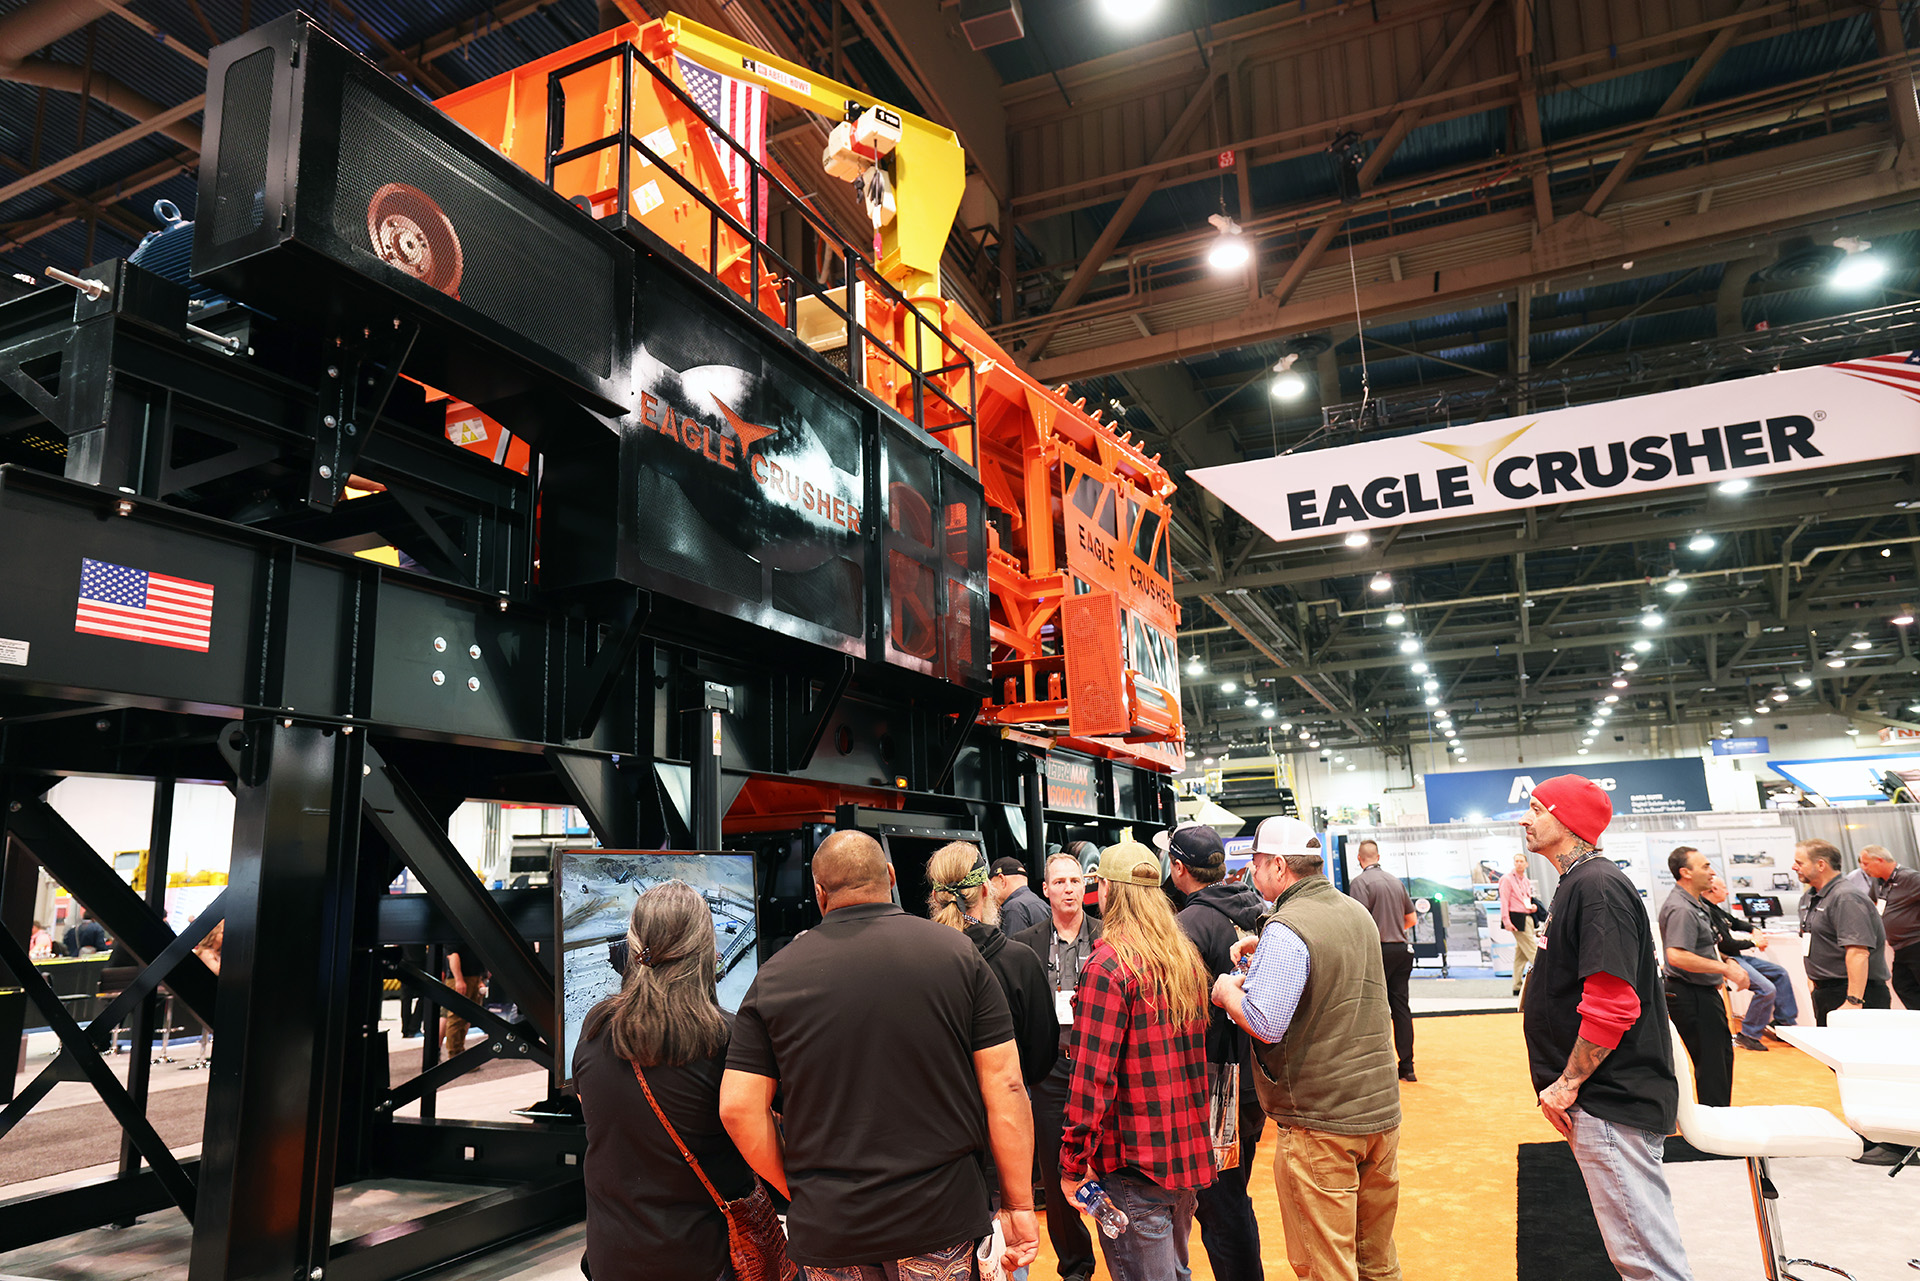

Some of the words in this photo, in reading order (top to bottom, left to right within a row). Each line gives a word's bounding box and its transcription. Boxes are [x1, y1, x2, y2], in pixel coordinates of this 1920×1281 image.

[640, 390, 737, 471] EAGLE
[750, 453, 862, 534] CRUSHER
[1287, 465, 1474, 531] EAGLE
[1493, 415, 1825, 500] CRUSHER
[1078, 523, 1115, 572] EAGLE
[1129, 564, 1173, 614] CRUSHER
